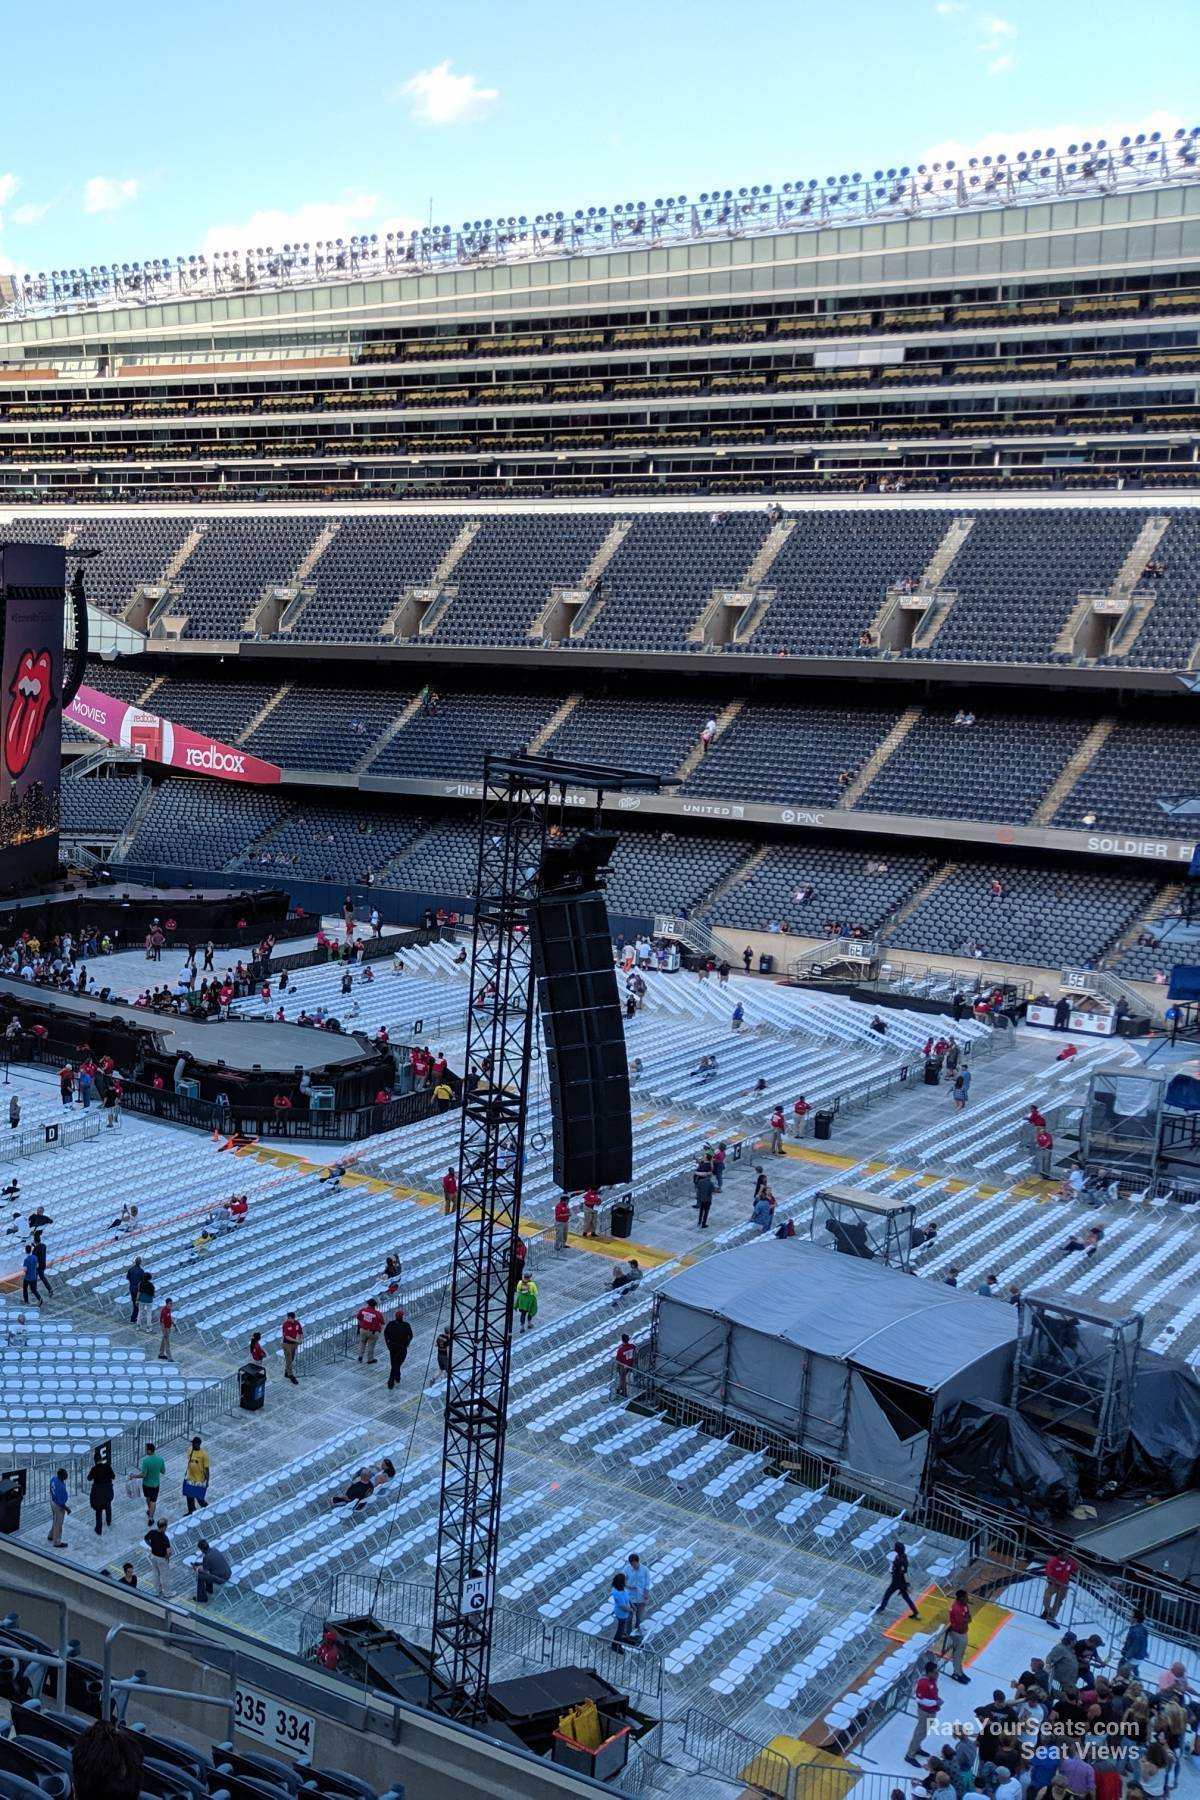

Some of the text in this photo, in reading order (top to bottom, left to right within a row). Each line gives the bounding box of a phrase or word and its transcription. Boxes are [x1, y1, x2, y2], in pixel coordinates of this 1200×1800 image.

[72, 699, 107, 725] MOVIES
[133, 713, 158, 723] redbox
[186, 745, 245, 773] redbox
[683, 804, 730, 815] UNITED
[796, 812, 825, 825] PNC
[1087, 837, 1168, 858] SOLDIER
[49, 1128, 55, 1140] D
[466, 1582, 482, 1593] PIT
[234, 1690, 310, 1746] 335 334
